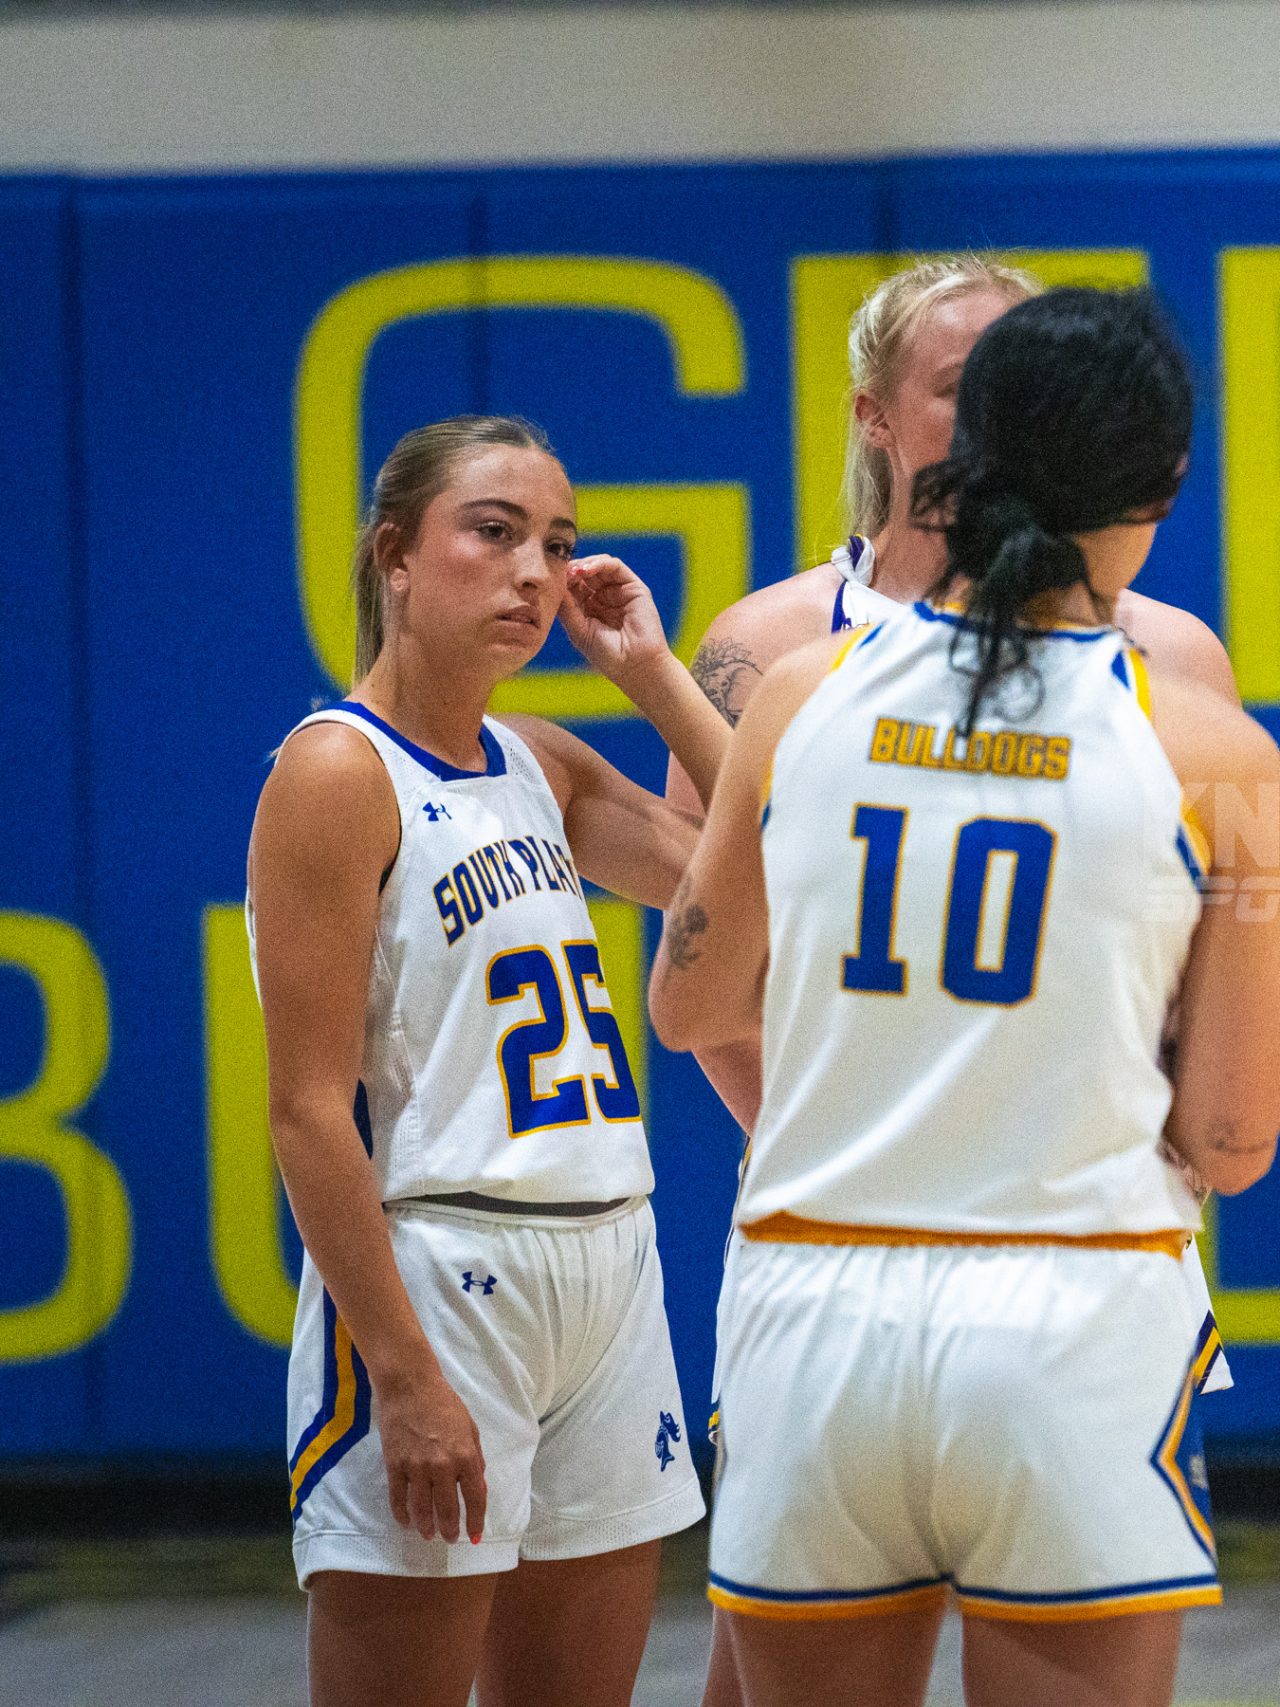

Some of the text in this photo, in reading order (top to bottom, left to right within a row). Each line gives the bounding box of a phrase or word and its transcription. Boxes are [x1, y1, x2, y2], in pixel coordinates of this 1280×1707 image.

[869, 715, 1073, 781] BULLDOGS
[432, 840, 526, 947] SOUTH
[840, 802, 1058, 1008] 10
[485, 940, 642, 1139] 25
